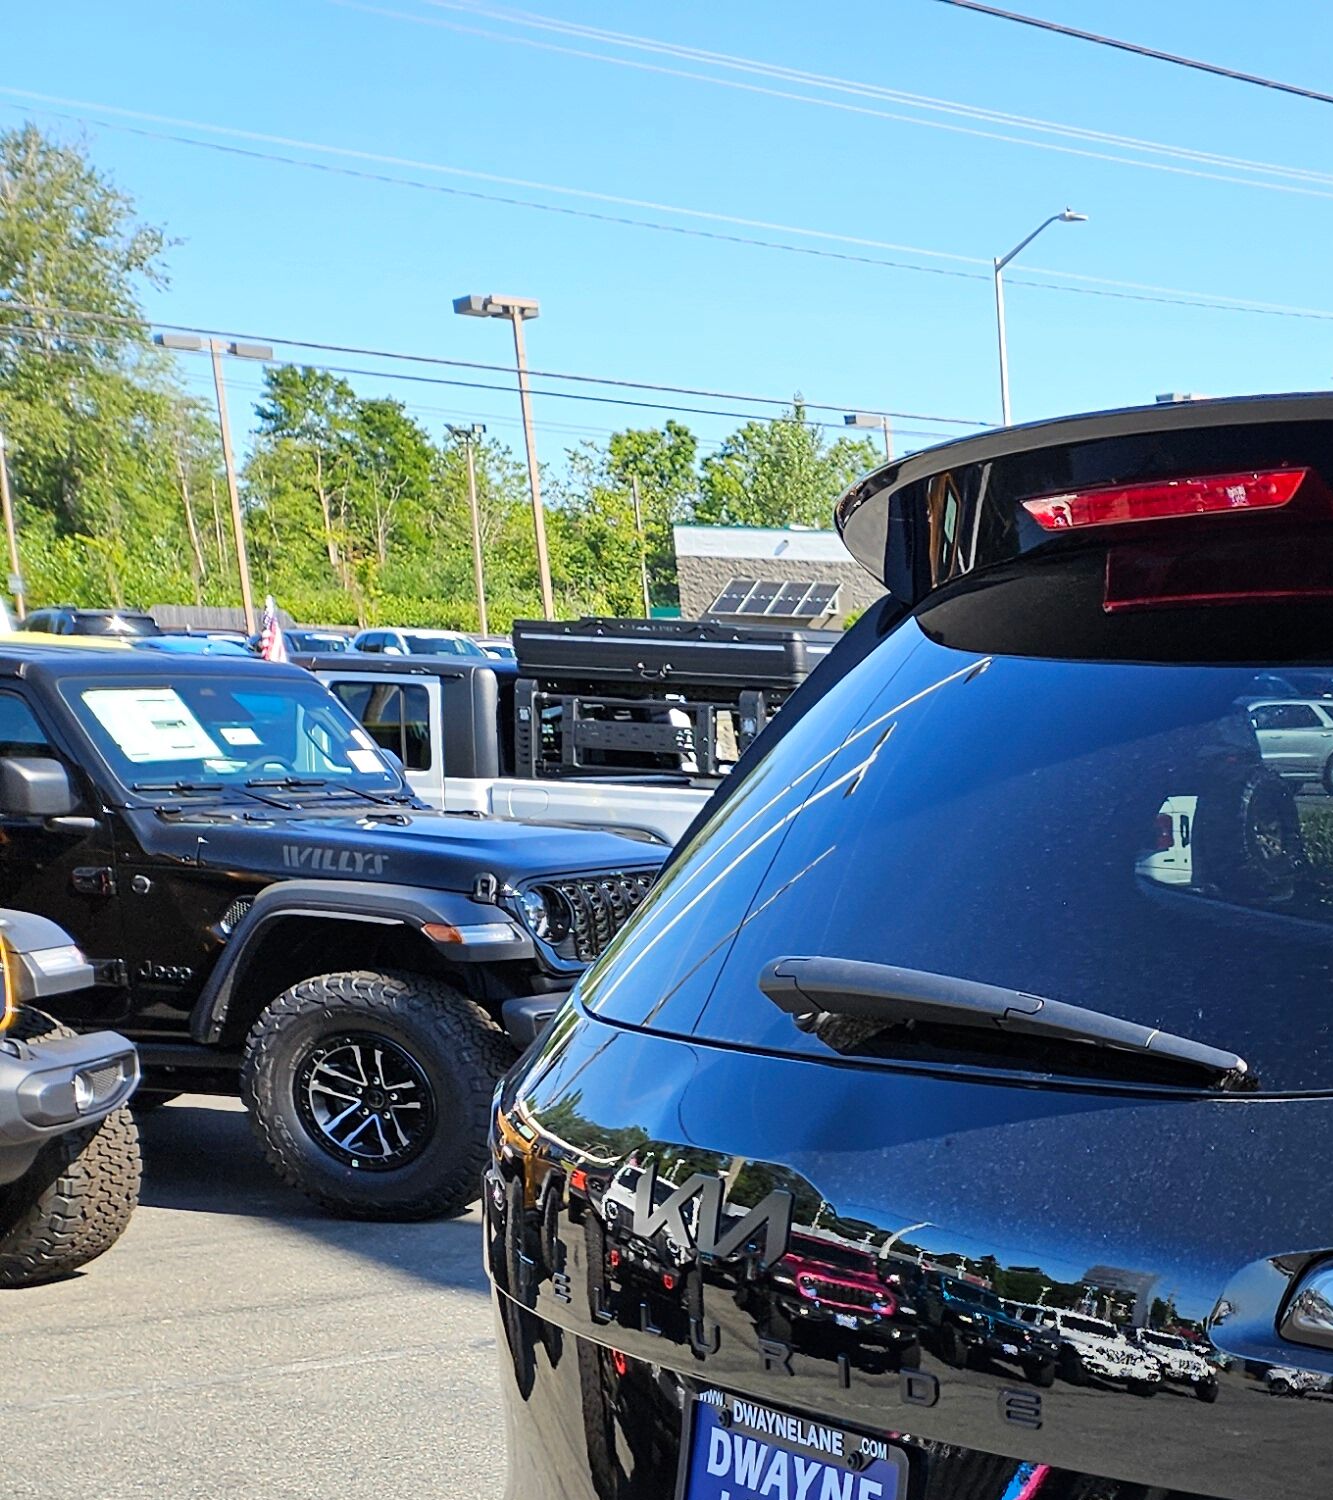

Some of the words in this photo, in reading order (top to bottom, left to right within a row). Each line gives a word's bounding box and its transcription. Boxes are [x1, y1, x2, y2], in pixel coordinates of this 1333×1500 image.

[283, 845, 389, 874] WILLYS
[140, 960, 192, 985] Jeep
[633, 1164, 795, 1267] KIA
[733, 1400, 845, 1456] DWAYNELANE
